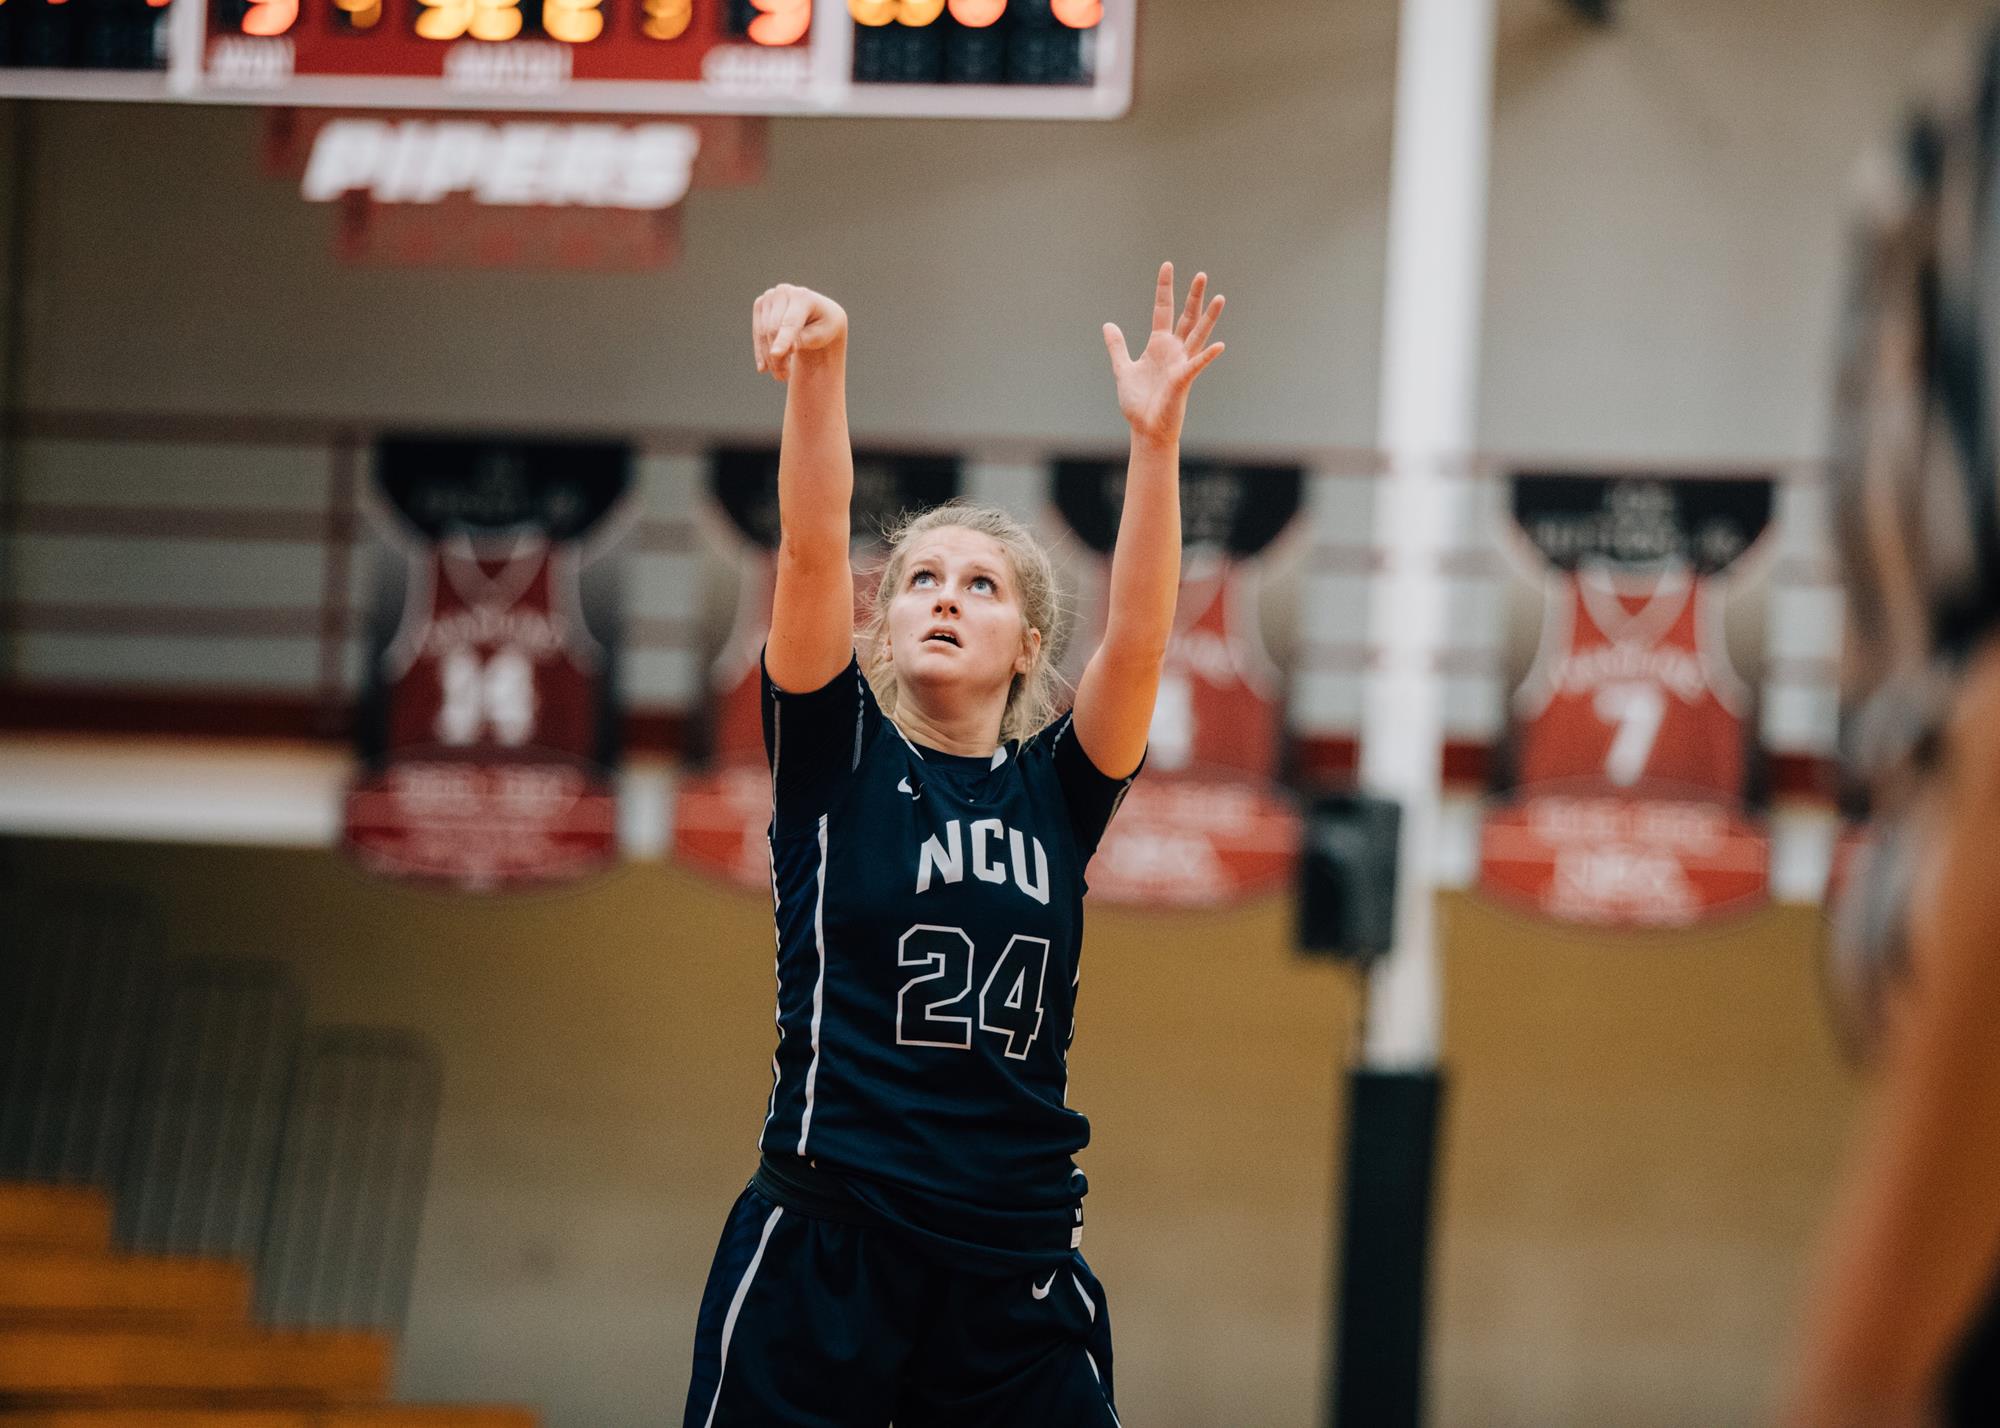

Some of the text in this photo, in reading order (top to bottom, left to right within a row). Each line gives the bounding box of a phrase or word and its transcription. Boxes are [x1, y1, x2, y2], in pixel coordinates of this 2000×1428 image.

[303, 119, 698, 209] PIPERS
[916, 818, 1050, 905] NCU
[896, 924, 1050, 1060] 24
